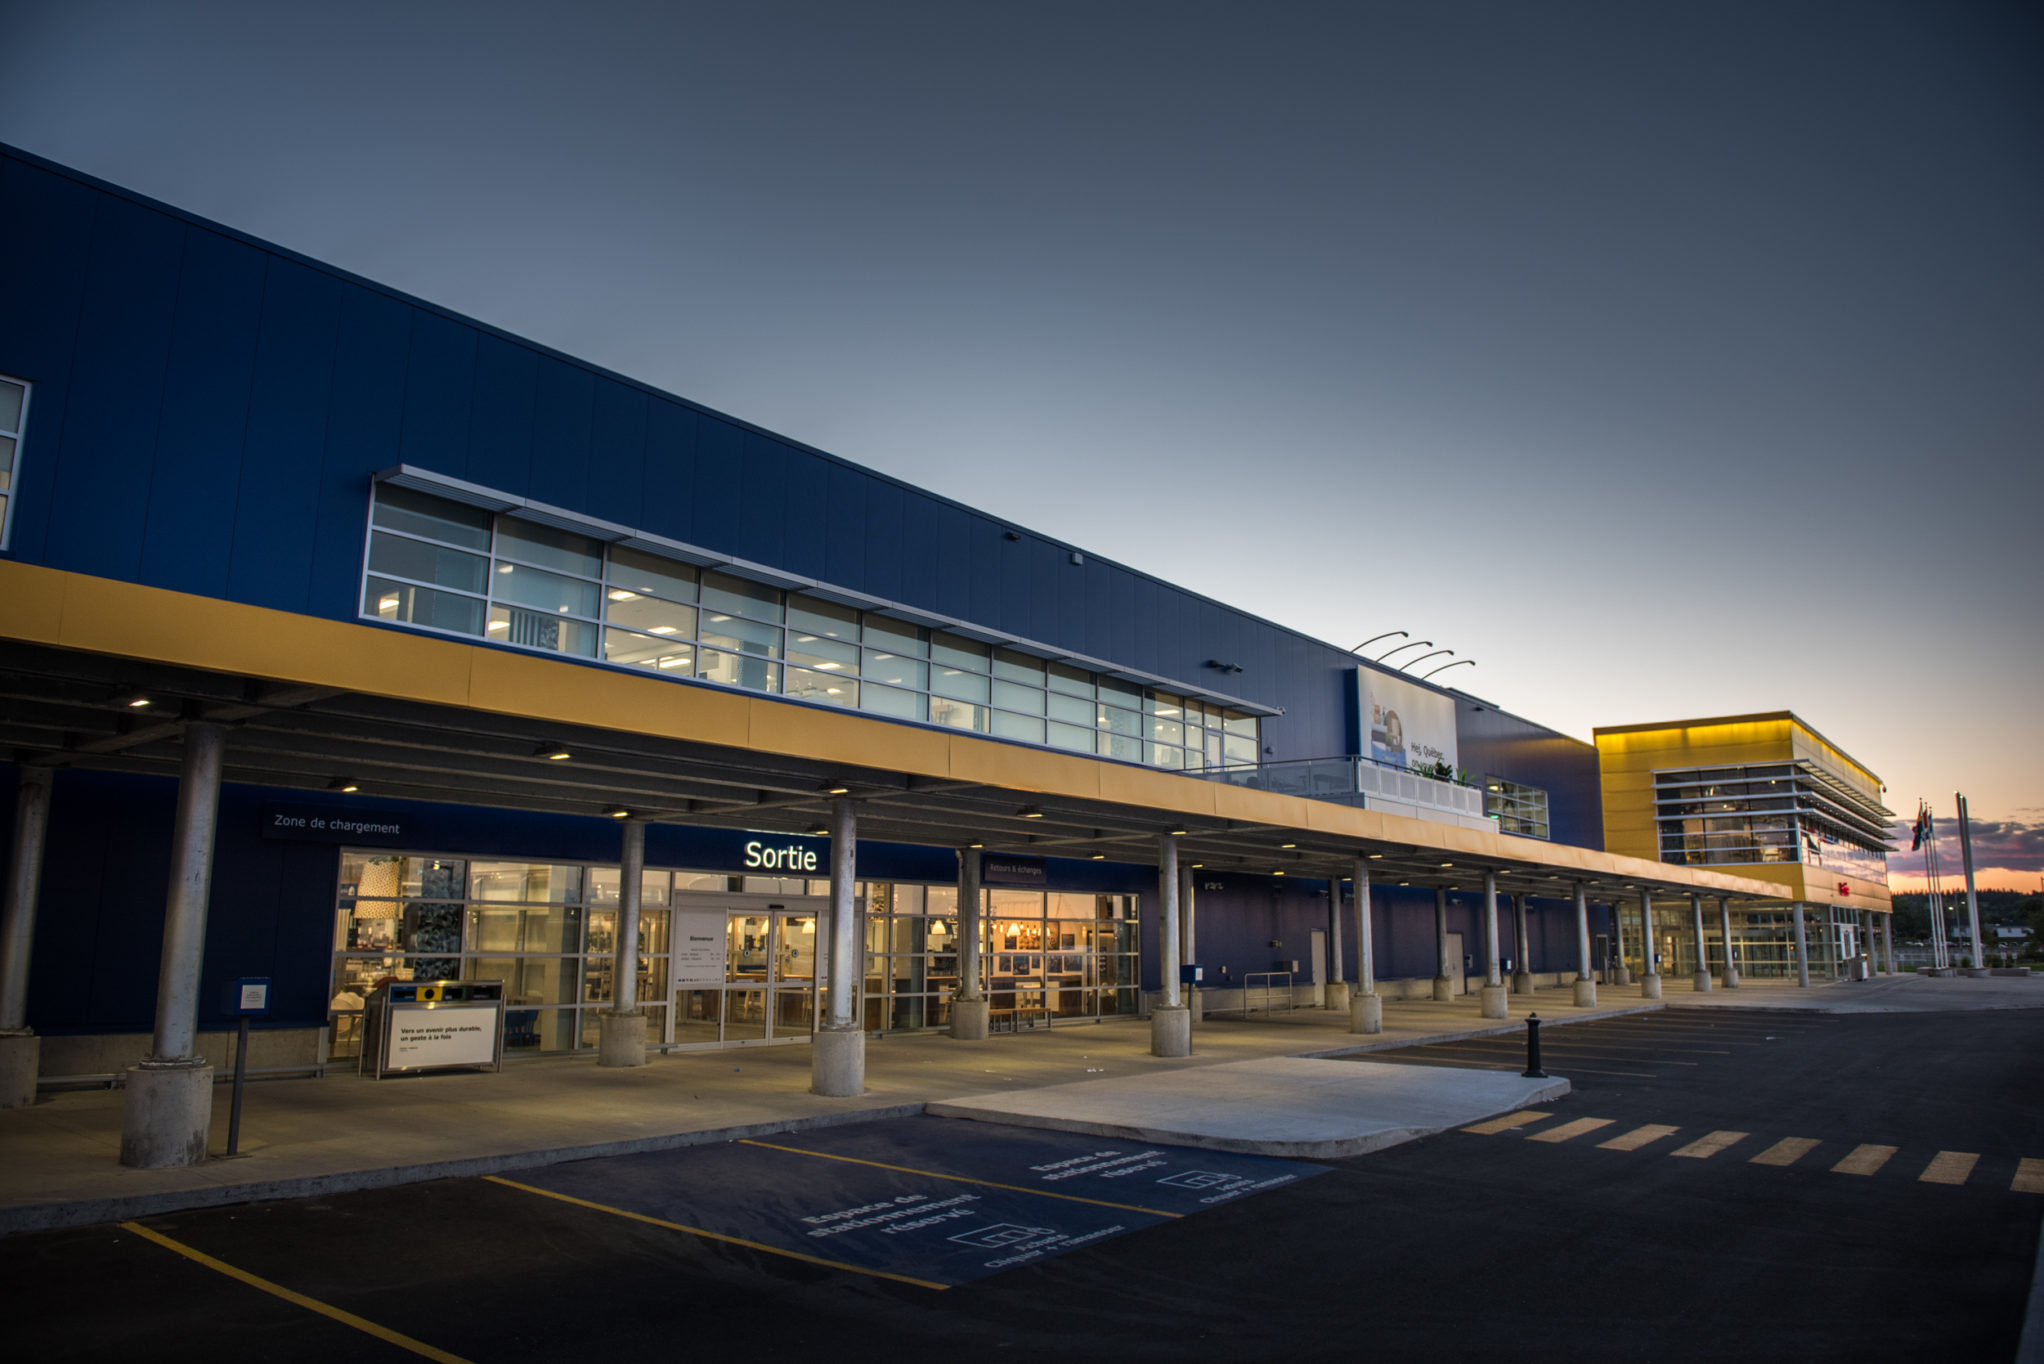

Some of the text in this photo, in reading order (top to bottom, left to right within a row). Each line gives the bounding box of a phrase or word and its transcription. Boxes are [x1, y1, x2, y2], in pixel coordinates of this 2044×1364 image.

[274, 814, 401, 834] Zone de chargement
[744, 841, 817, 871] Sortie
[800, 1194, 928, 1224] Espace de
[806, 1193, 982, 1238] stationnement
[880, 1208, 976, 1234] réservé
